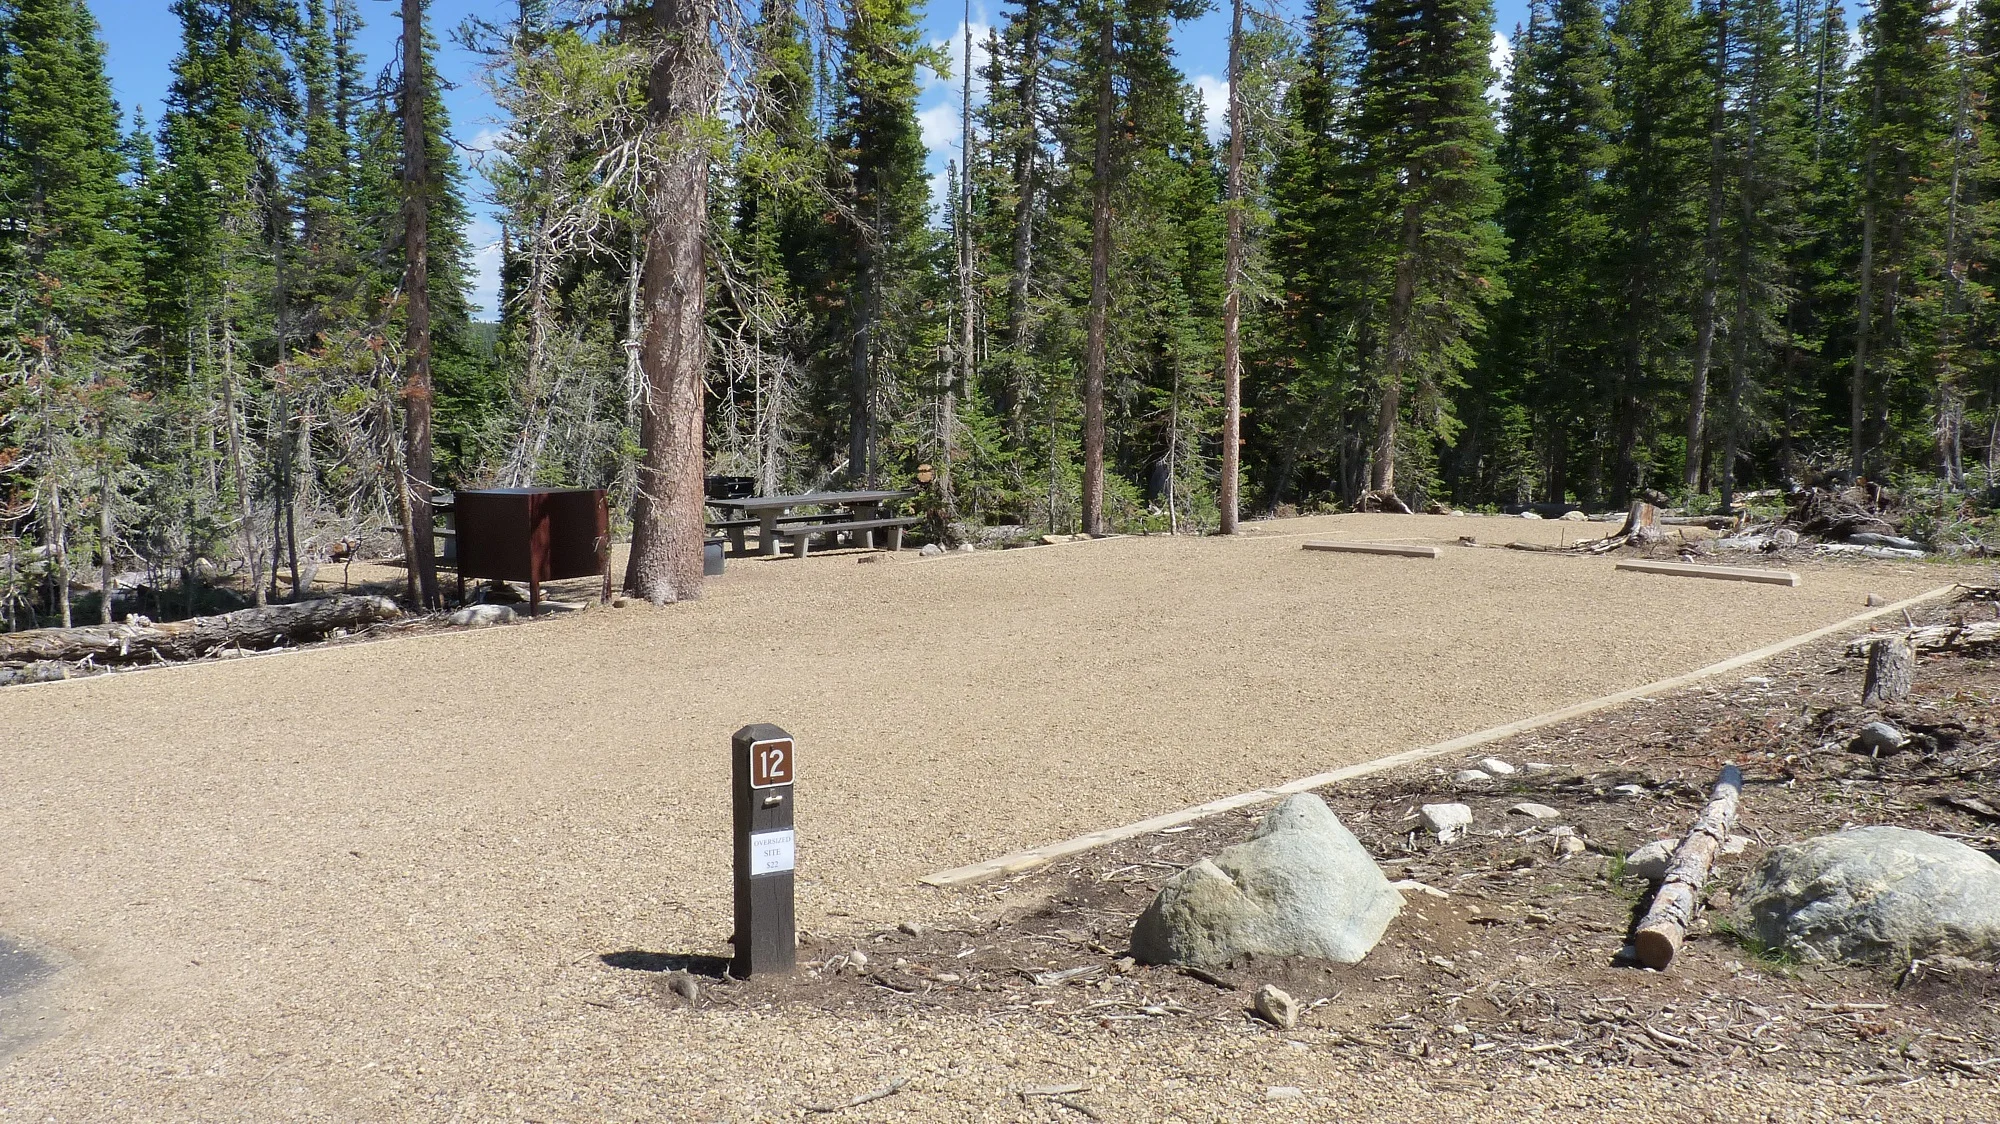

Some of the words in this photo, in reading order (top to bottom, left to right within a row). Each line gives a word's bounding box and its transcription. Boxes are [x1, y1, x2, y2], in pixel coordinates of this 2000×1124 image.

[760, 749, 784, 778] 12
[753, 836, 791, 846] OVERSIZED
[763, 848, 781, 857] SITE
